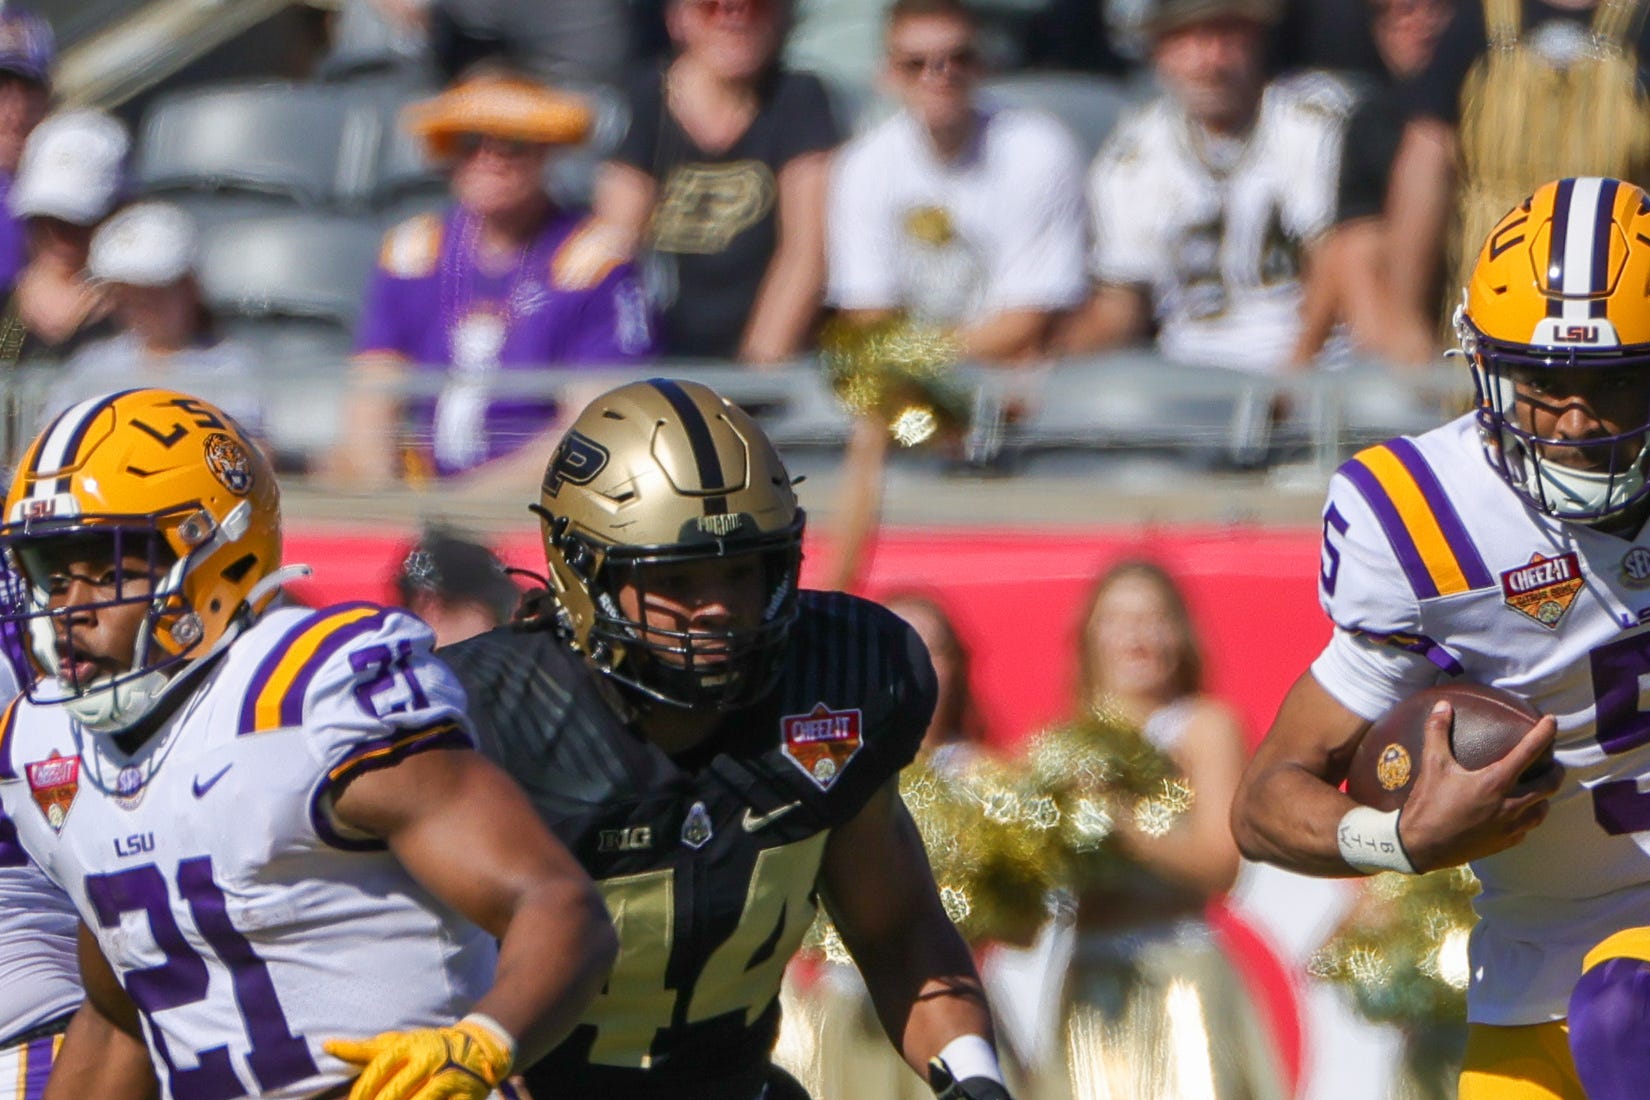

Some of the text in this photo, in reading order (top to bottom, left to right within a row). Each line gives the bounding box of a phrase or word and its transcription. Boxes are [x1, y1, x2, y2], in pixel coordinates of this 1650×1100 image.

[1553, 325, 1598, 343] LSU
[541, 429, 610, 498] P
[22, 500, 56, 519] LSU
[1320, 500, 1350, 598] 5
[348, 639, 431, 719] 21
[113, 831, 156, 858] LSU
